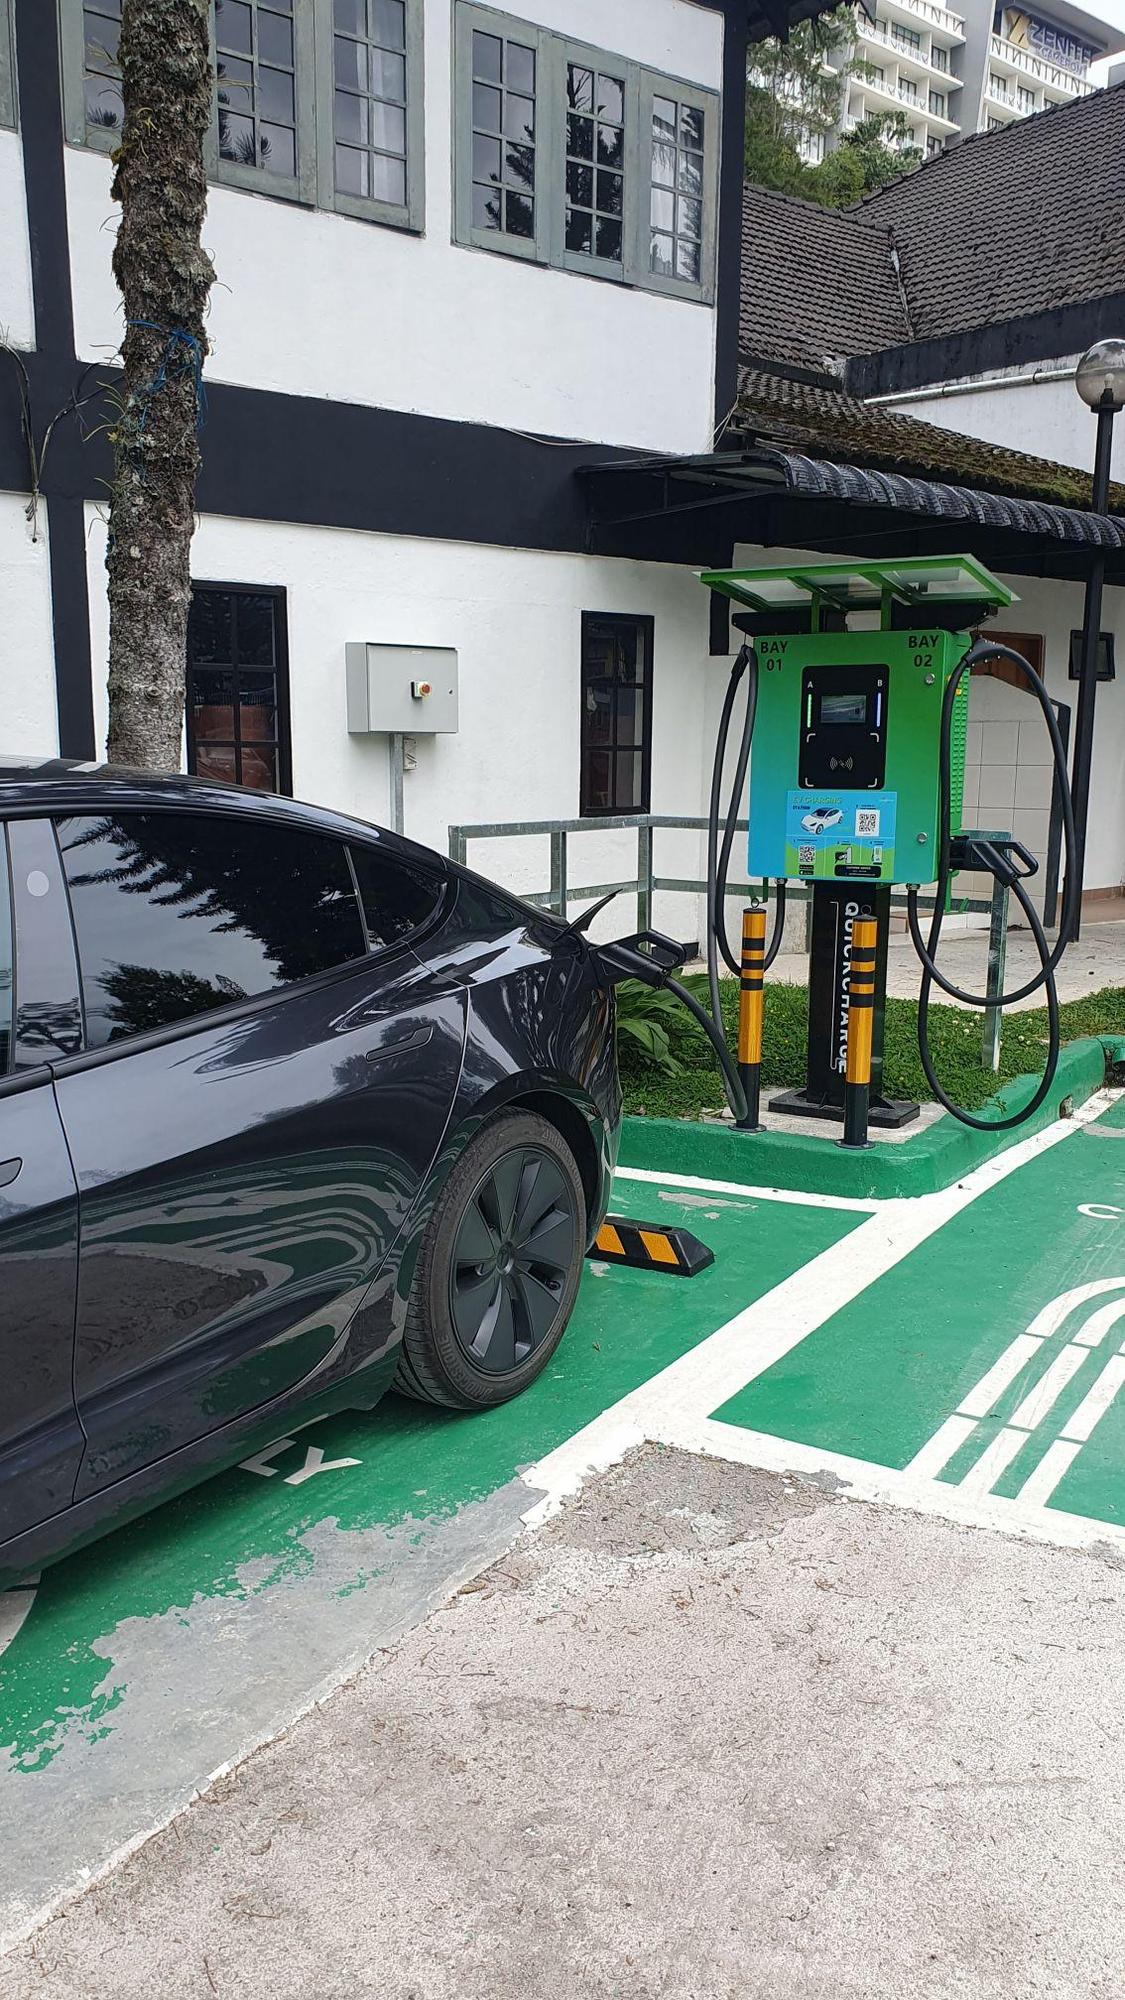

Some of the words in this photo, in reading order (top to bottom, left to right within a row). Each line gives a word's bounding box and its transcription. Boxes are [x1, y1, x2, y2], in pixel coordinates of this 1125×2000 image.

[1028, 22, 1092, 69] ZENITH
[760, 641, 788, 654] BAY
[908, 635, 939, 648] BAY
[766, 658, 783, 671] 01
[914, 654, 932, 667] 02
